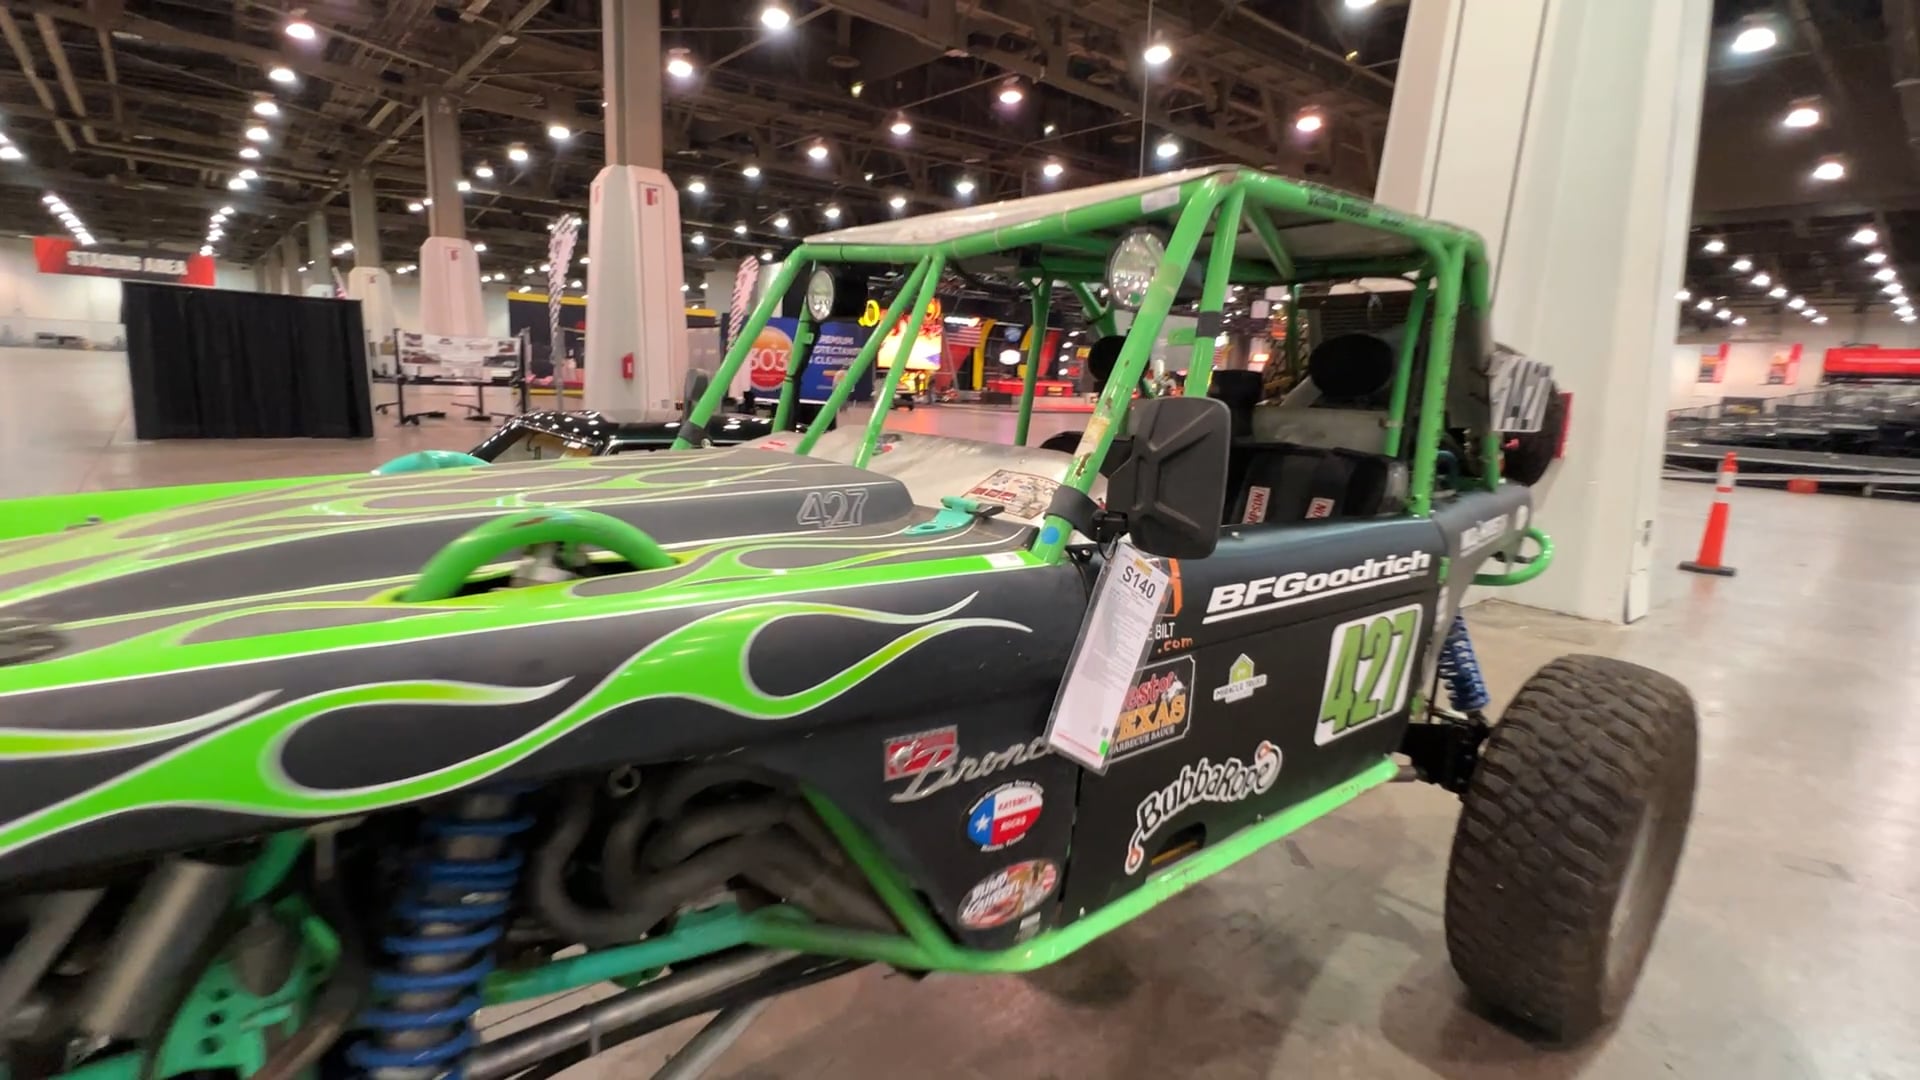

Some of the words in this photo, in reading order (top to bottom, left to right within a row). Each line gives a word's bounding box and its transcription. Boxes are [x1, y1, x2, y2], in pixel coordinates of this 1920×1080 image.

[797, 487, 869, 529] 427
[1122, 565, 1156, 599] S140
[1206, 550, 1431, 614] BFGoodrich
[1155, 622, 1176, 639] BILT
[1125, 673, 1160, 710] est
[1320, 609, 1418, 735] 427
[1117, 694, 1187, 741] EXAS
[1112, 734, 1149, 754] ARBECUE
[890, 736, 1052, 803] Bronc
